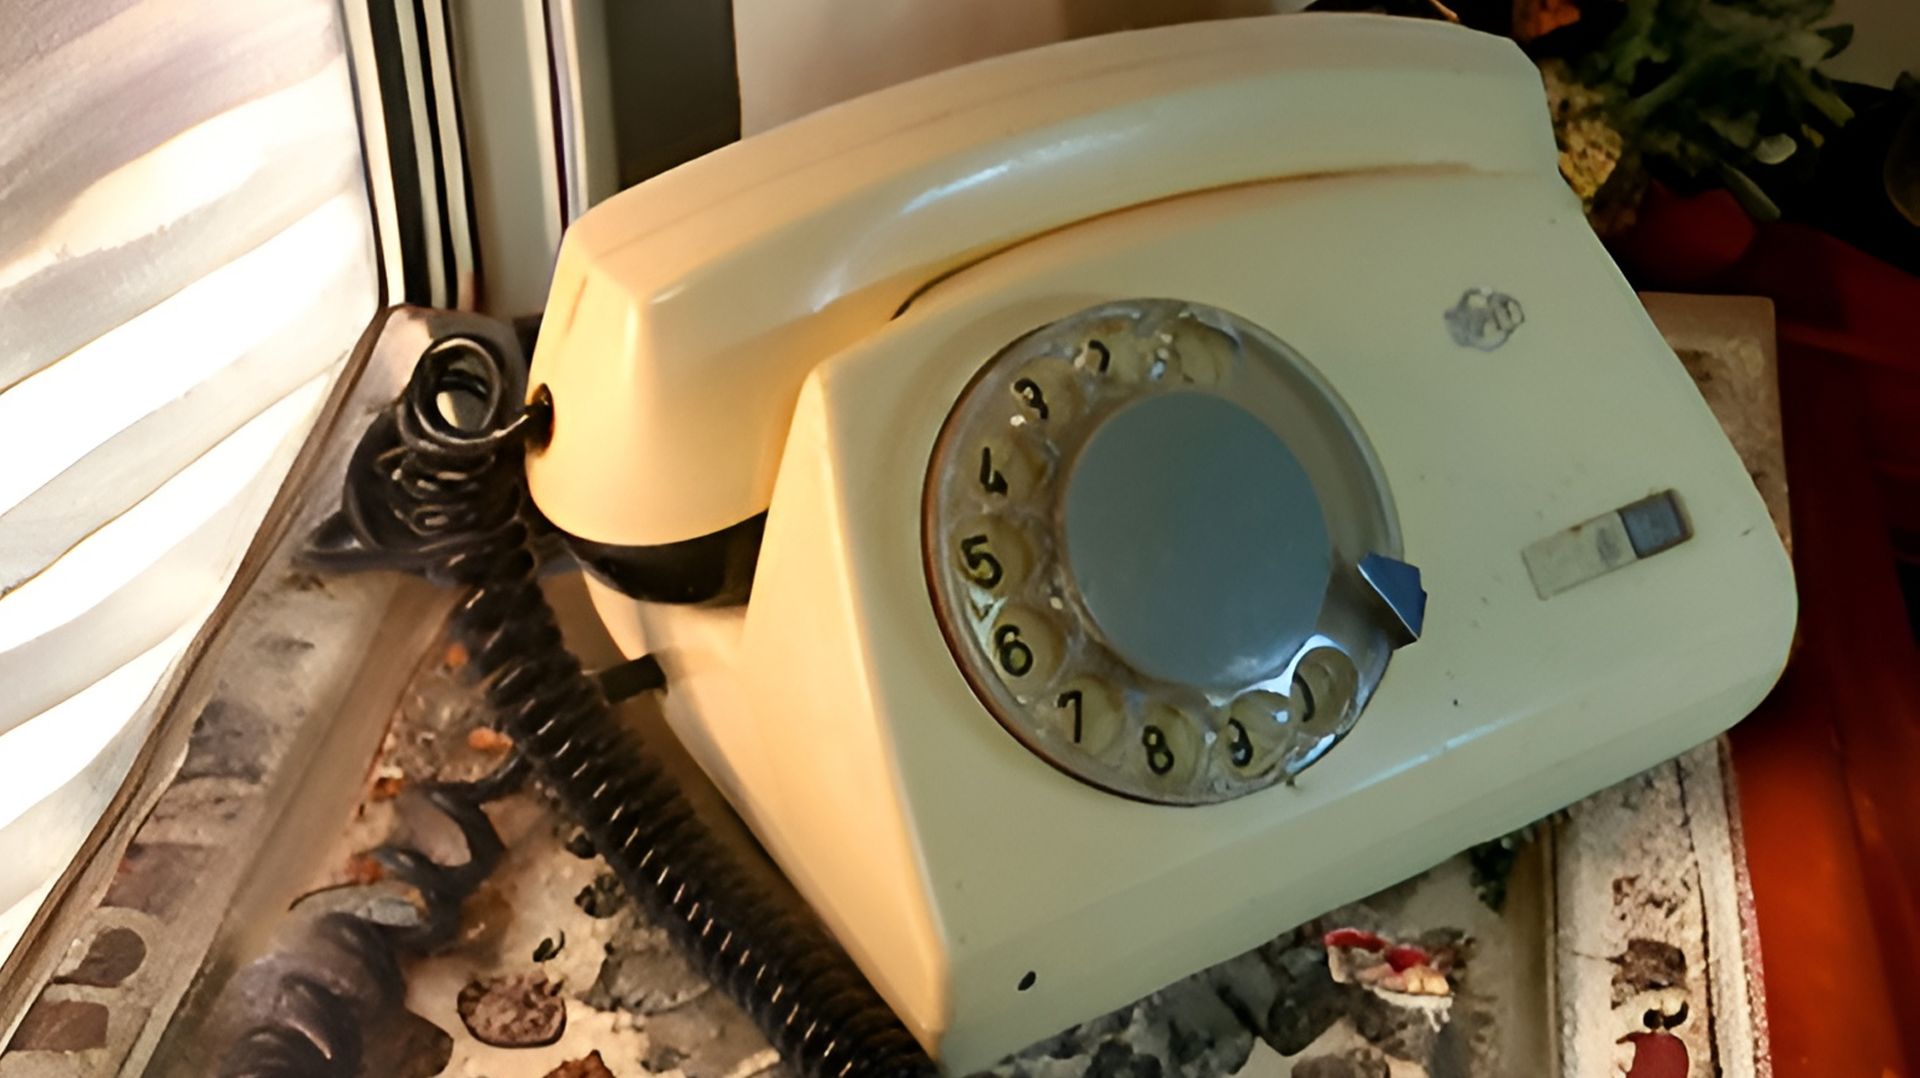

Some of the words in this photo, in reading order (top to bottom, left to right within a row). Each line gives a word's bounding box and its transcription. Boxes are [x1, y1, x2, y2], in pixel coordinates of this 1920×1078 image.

[980, 446, 1009, 497] 4
[961, 534, 1004, 590] 5
[995, 624, 1034, 678] 6
[1057, 690, 1083, 744] 7
[1141, 724, 1175, 776] 8
